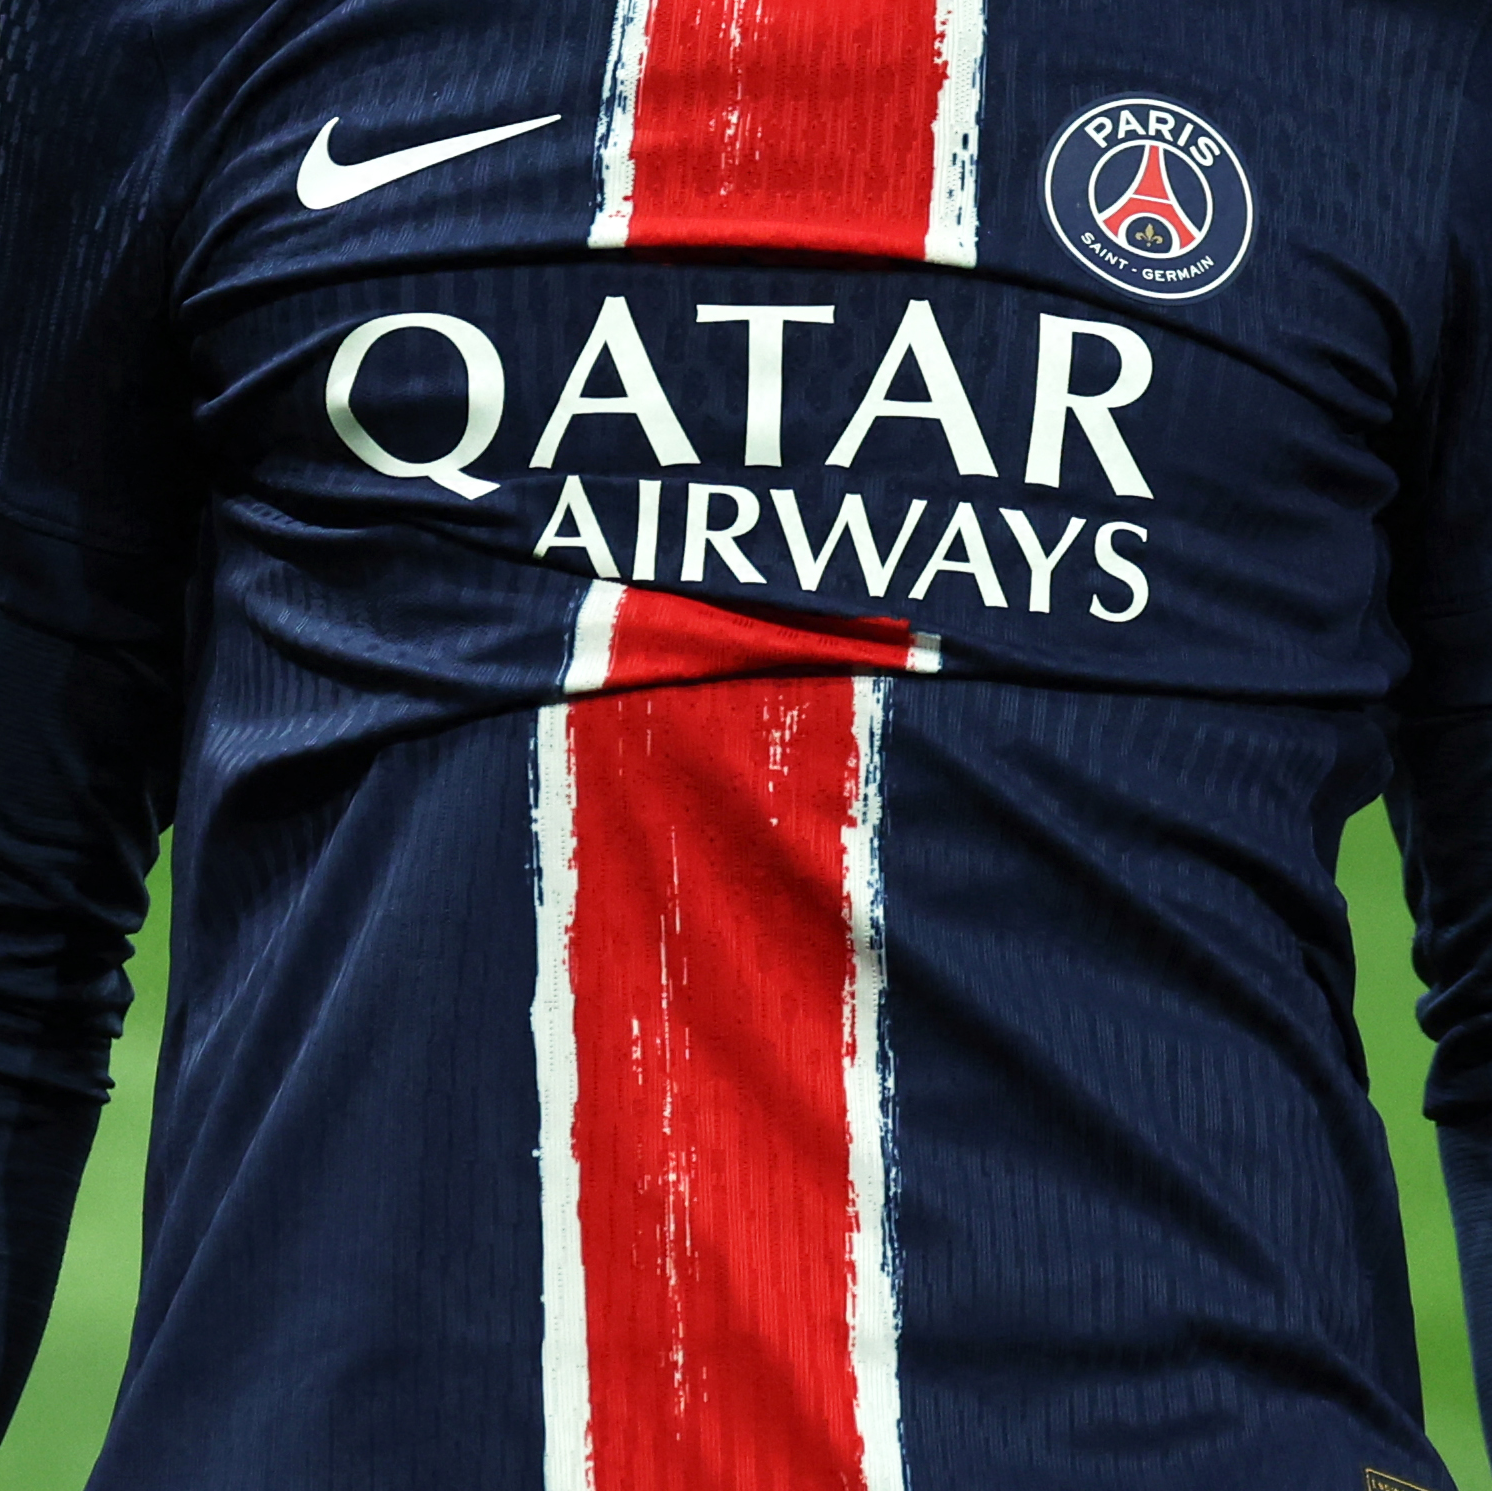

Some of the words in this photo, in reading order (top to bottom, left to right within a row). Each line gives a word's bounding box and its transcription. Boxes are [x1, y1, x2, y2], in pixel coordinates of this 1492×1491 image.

[1083, 109, 1221, 167] PARIS
[1080, 231, 1129, 270] SAINT
[1141, 255, 1215, 282] GERMAIN
[325, 295, 1154, 501] QATAR
[533, 474, 1149, 623] AIRWAYS
